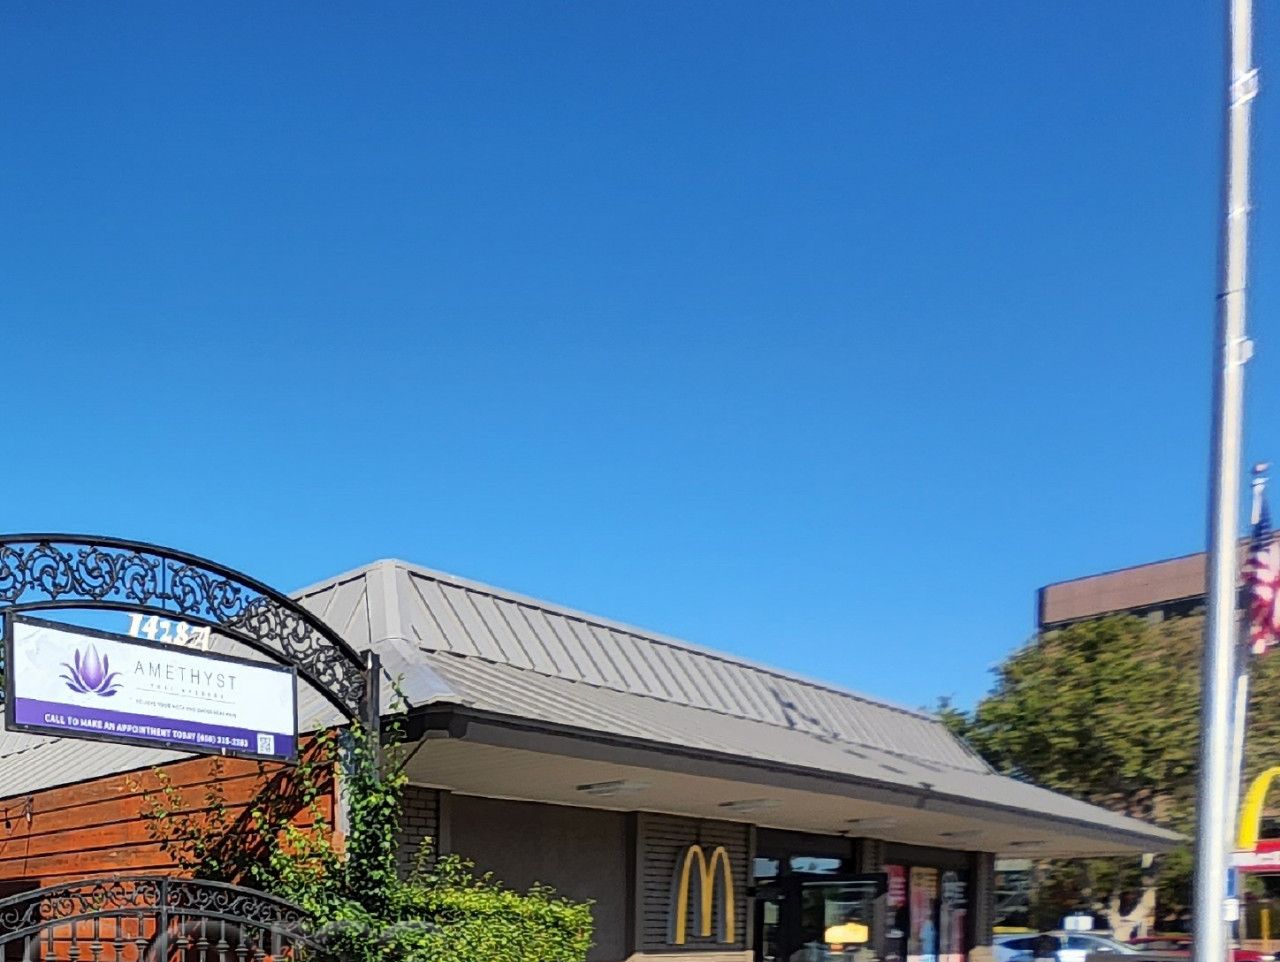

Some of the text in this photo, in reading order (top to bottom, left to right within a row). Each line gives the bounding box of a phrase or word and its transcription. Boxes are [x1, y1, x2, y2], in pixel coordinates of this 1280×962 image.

[127, 611, 212, 652] 1428A
[134, 660, 237, 690] AMETHYST
[44, 713, 66, 725] CALL
[67, 716, 80, 726] TO
[80, 718, 103, 729] MAKE
[103, 721, 116, 731] AN
[116, 723, 172, 737] APPOINTMENT
[172, 729, 196, 740] TODAY
